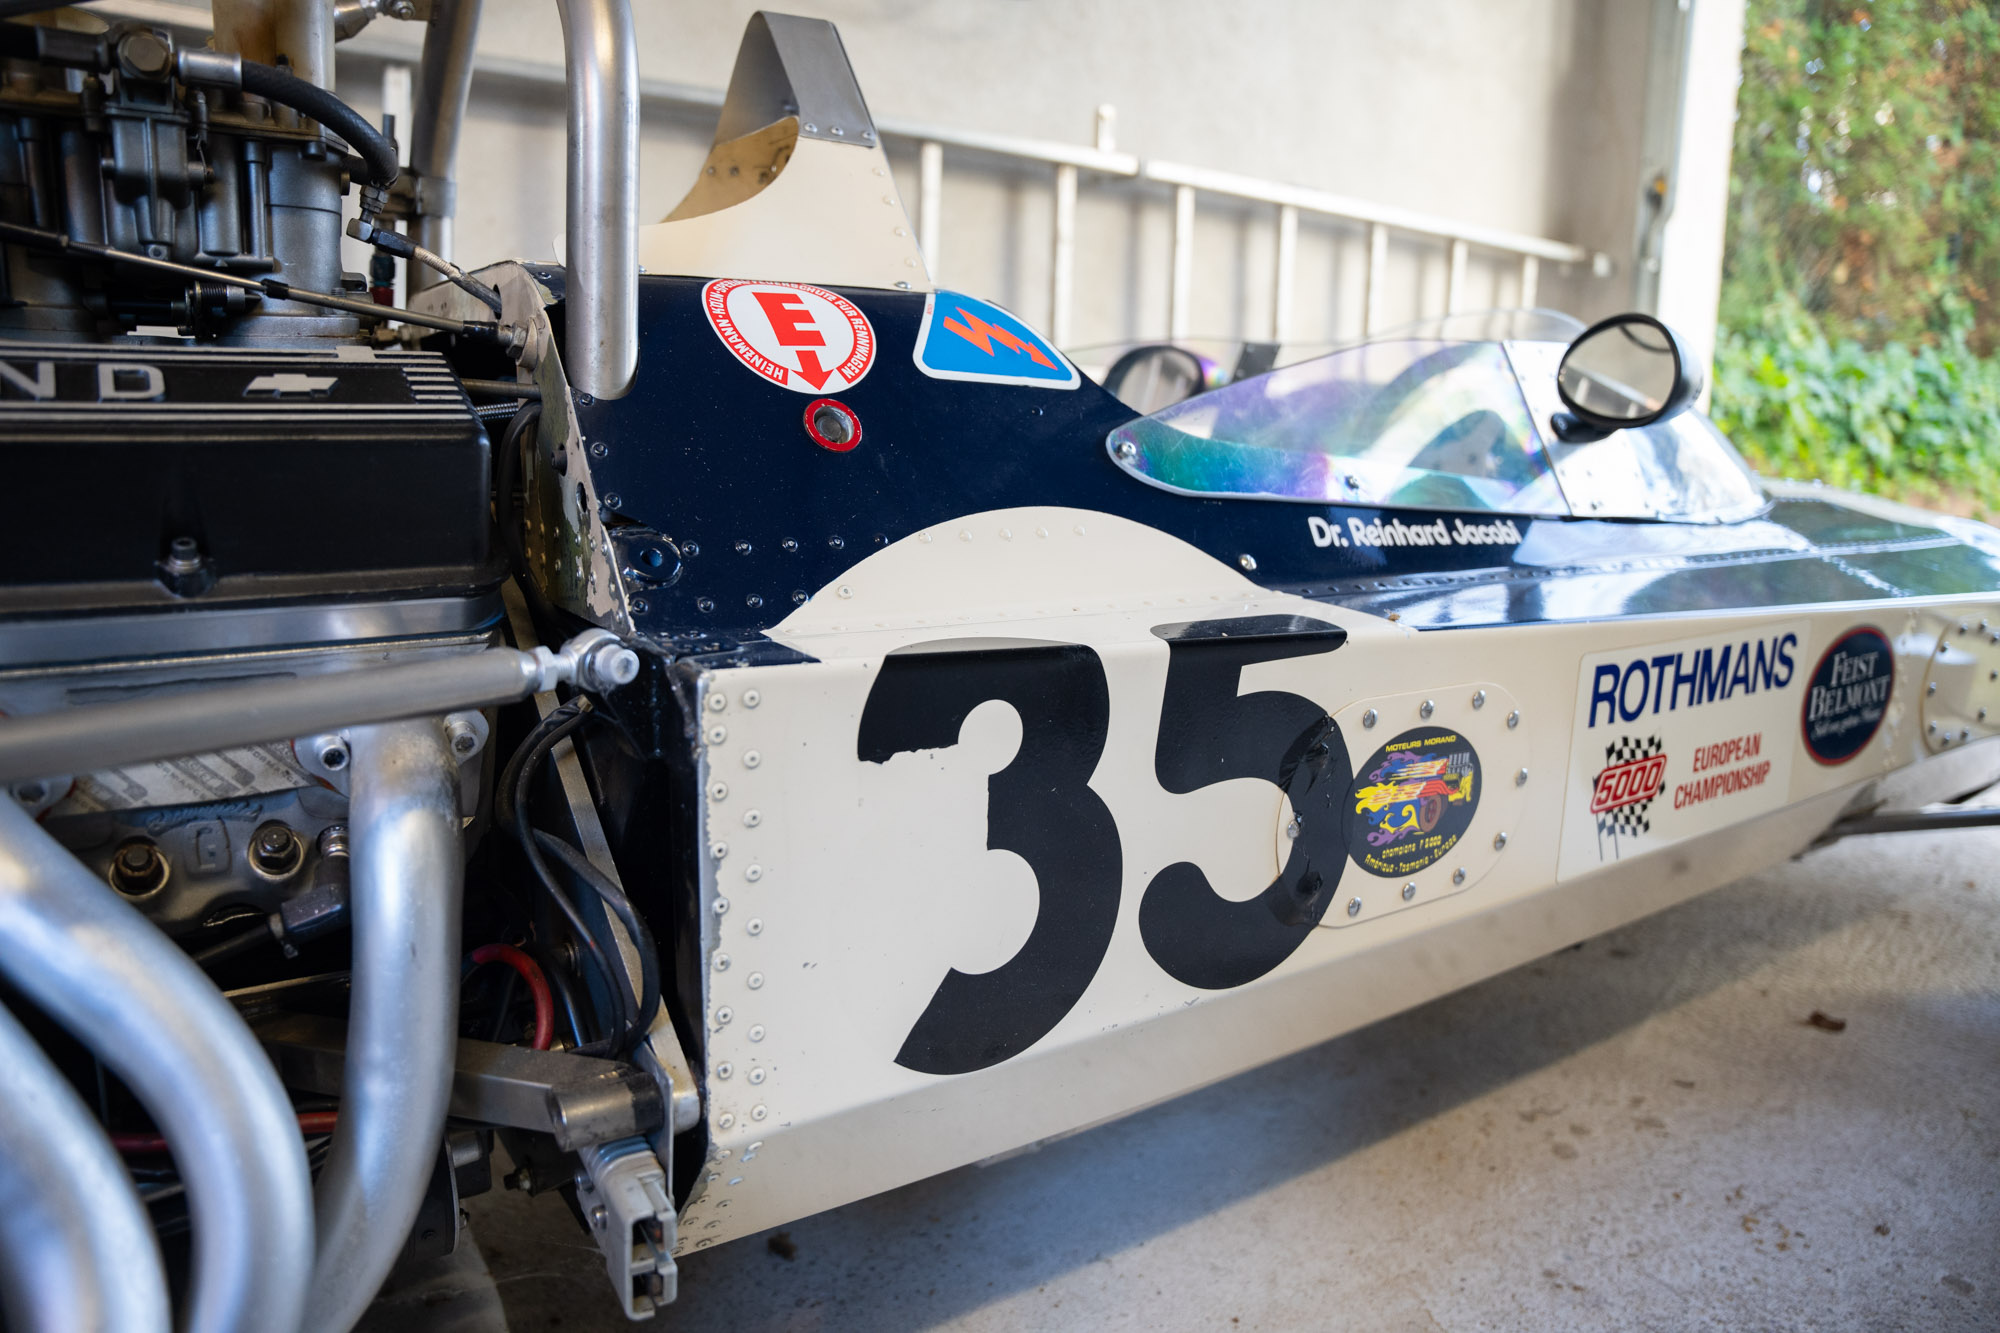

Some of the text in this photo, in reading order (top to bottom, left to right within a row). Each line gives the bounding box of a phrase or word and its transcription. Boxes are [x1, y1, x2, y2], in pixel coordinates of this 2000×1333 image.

[752, 292, 827, 347] E
[716, 319, 784, 380] HEINZMANN
[841, 318, 870, 379] RENNWAGEN
[1308, 516, 1523, 547] Dr. Reinhard Jacobi
[1588, 632, 1798, 729] ROTHMANS
[1808, 674, 1891, 721] BELMONT
[1385, 740, 1422, 752] MOTEURS
[1693, 733, 1762, 773] EUROPEAN
[1594, 763, 1663, 806] 5000
[1674, 760, 1771, 810] CHAMPIONSHIP
[857, 614, 1354, 1075] 35
